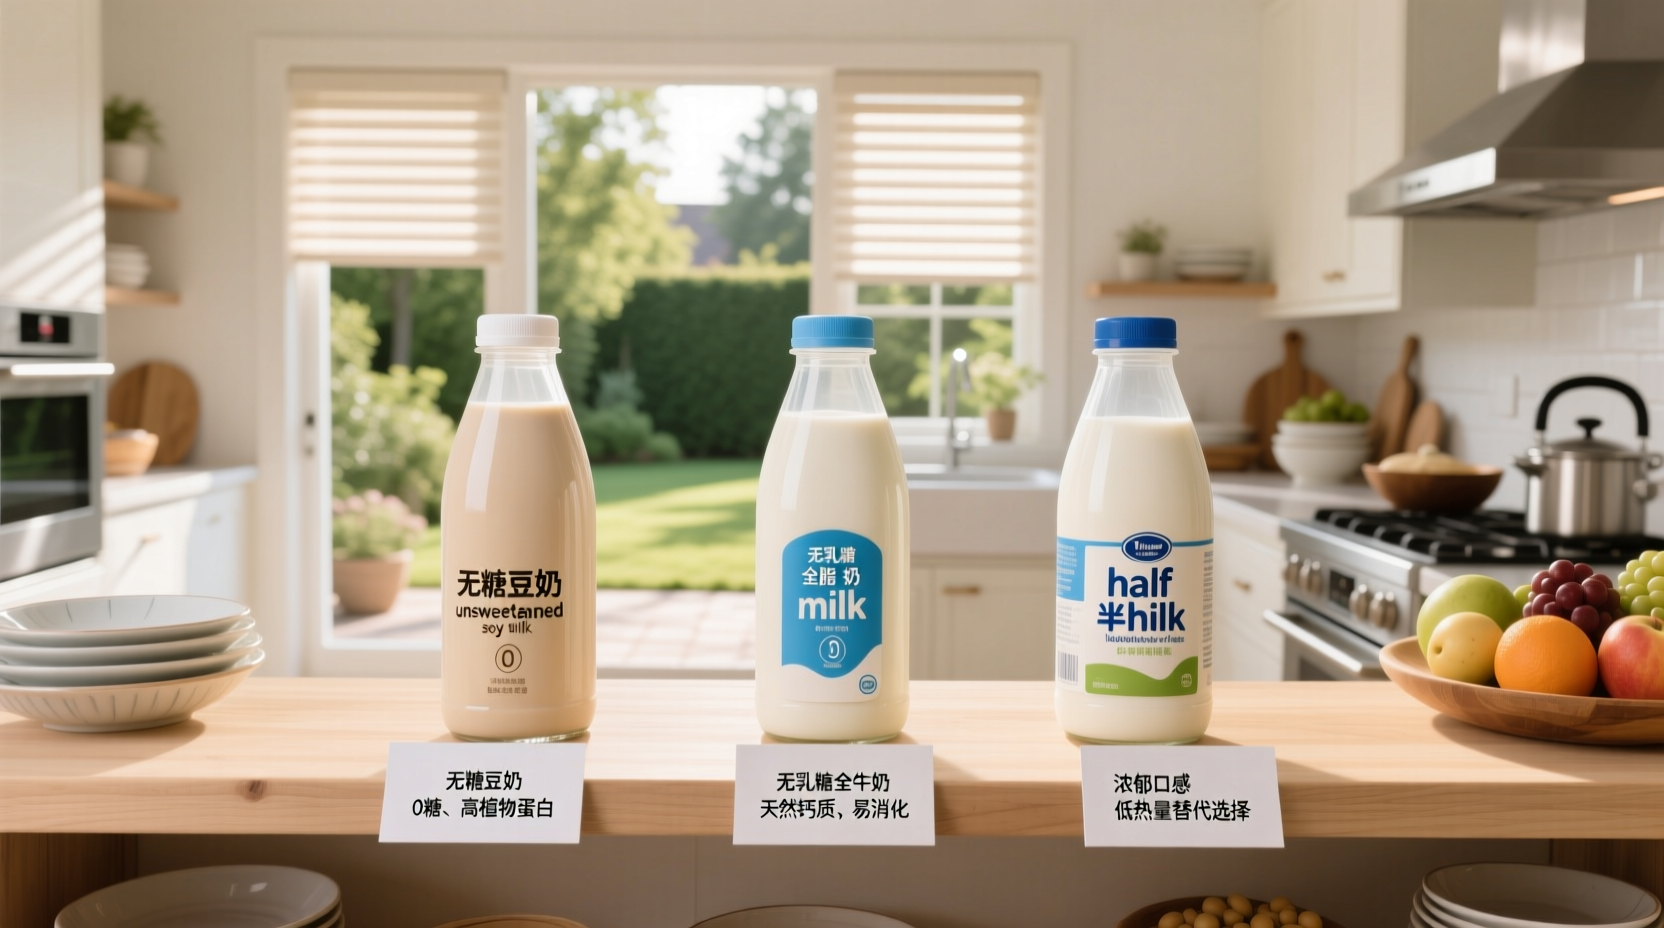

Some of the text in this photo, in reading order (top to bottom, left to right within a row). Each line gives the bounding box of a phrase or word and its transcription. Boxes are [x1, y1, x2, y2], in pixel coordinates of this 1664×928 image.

[457, 568, 562, 598] 无糖豆奶
[843, 567, 860, 586] 奶
[1108, 567, 1174, 598] half
[798, 589, 867, 620] milk
[482, 624, 504, 638] soy
[446, 770, 522, 792] 无糖豆奶
[776, 771, 890, 793] 无乳糖全牛奶
[1113, 773, 1191, 795] 浓郁口感
[1114, 799, 1251, 822] 低热量替代选择
